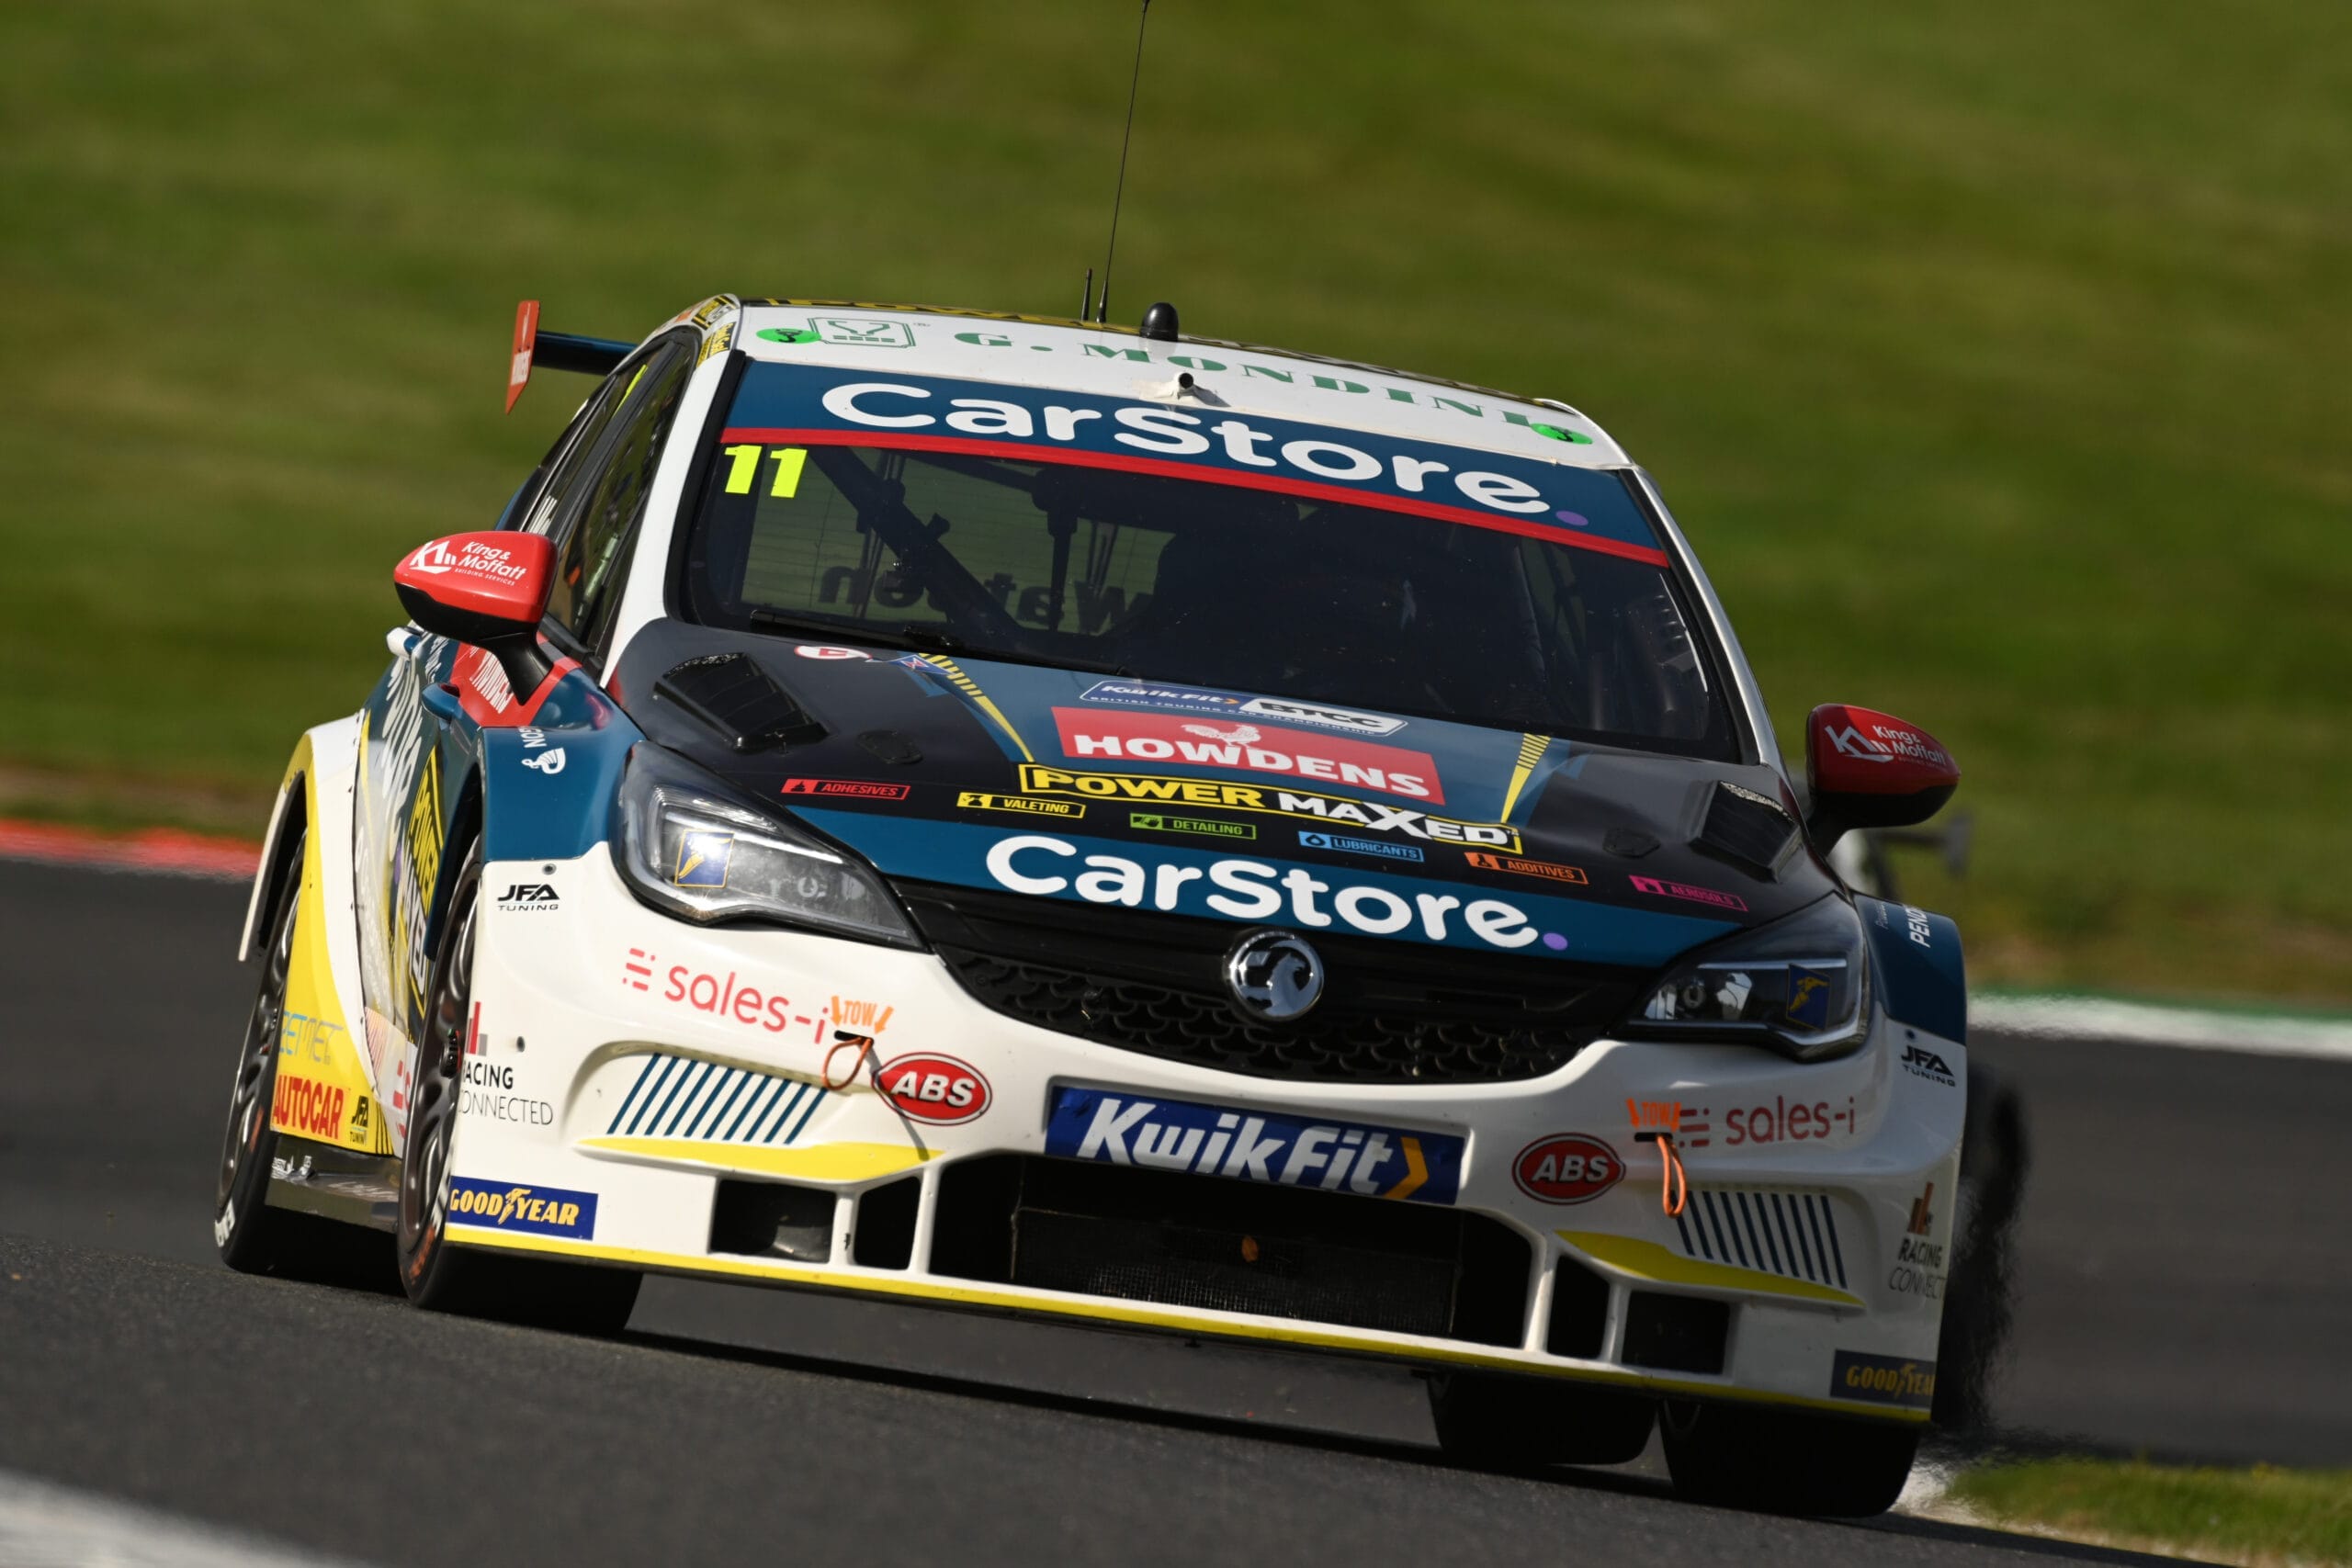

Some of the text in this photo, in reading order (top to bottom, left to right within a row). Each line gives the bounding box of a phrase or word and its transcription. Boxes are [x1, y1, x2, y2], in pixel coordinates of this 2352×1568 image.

[1082, 343, 1531, 427] MONDINI
[724, 446, 808, 498] 11
[458, 554, 527, 580] Moffatt
[1259, 702, 1382, 728] BTCC
[519, 727, 547, 748] GON
[1074, 735, 1430, 796] HOWDENS
[820, 782, 898, 796] ADHESIVES
[1032, 769, 1264, 807] POWER
[1003, 797, 1069, 814] VALETING
[1173, 819, 1243, 835] DETAILING
[1333, 838, 1418, 860] LUBRICANTS
[1507, 860, 1575, 879] ADDITIVES
[497, 884, 560, 901] JFA
[1670, 886, 1733, 906] AEROSOLS
[498, 904, 559, 912] TUNING
[664, 964, 829, 1044] sales-i
[843, 999, 876, 1028] TOW
[1901, 1045, 1954, 1077] JFA
[889, 1070, 976, 1108] ABS
[1903, 1065, 1956, 1087] TUNING
[272, 1075, 344, 1140] AUTOCAR
[1641, 1101, 1670, 1126] TOW
[1725, 1096, 1855, 1145] sales-i
[1532, 1154, 1610, 1183] ABS
[449, 1189, 580, 1226] GOODYEAR
[1898, 1238, 1943, 1269] RACING
